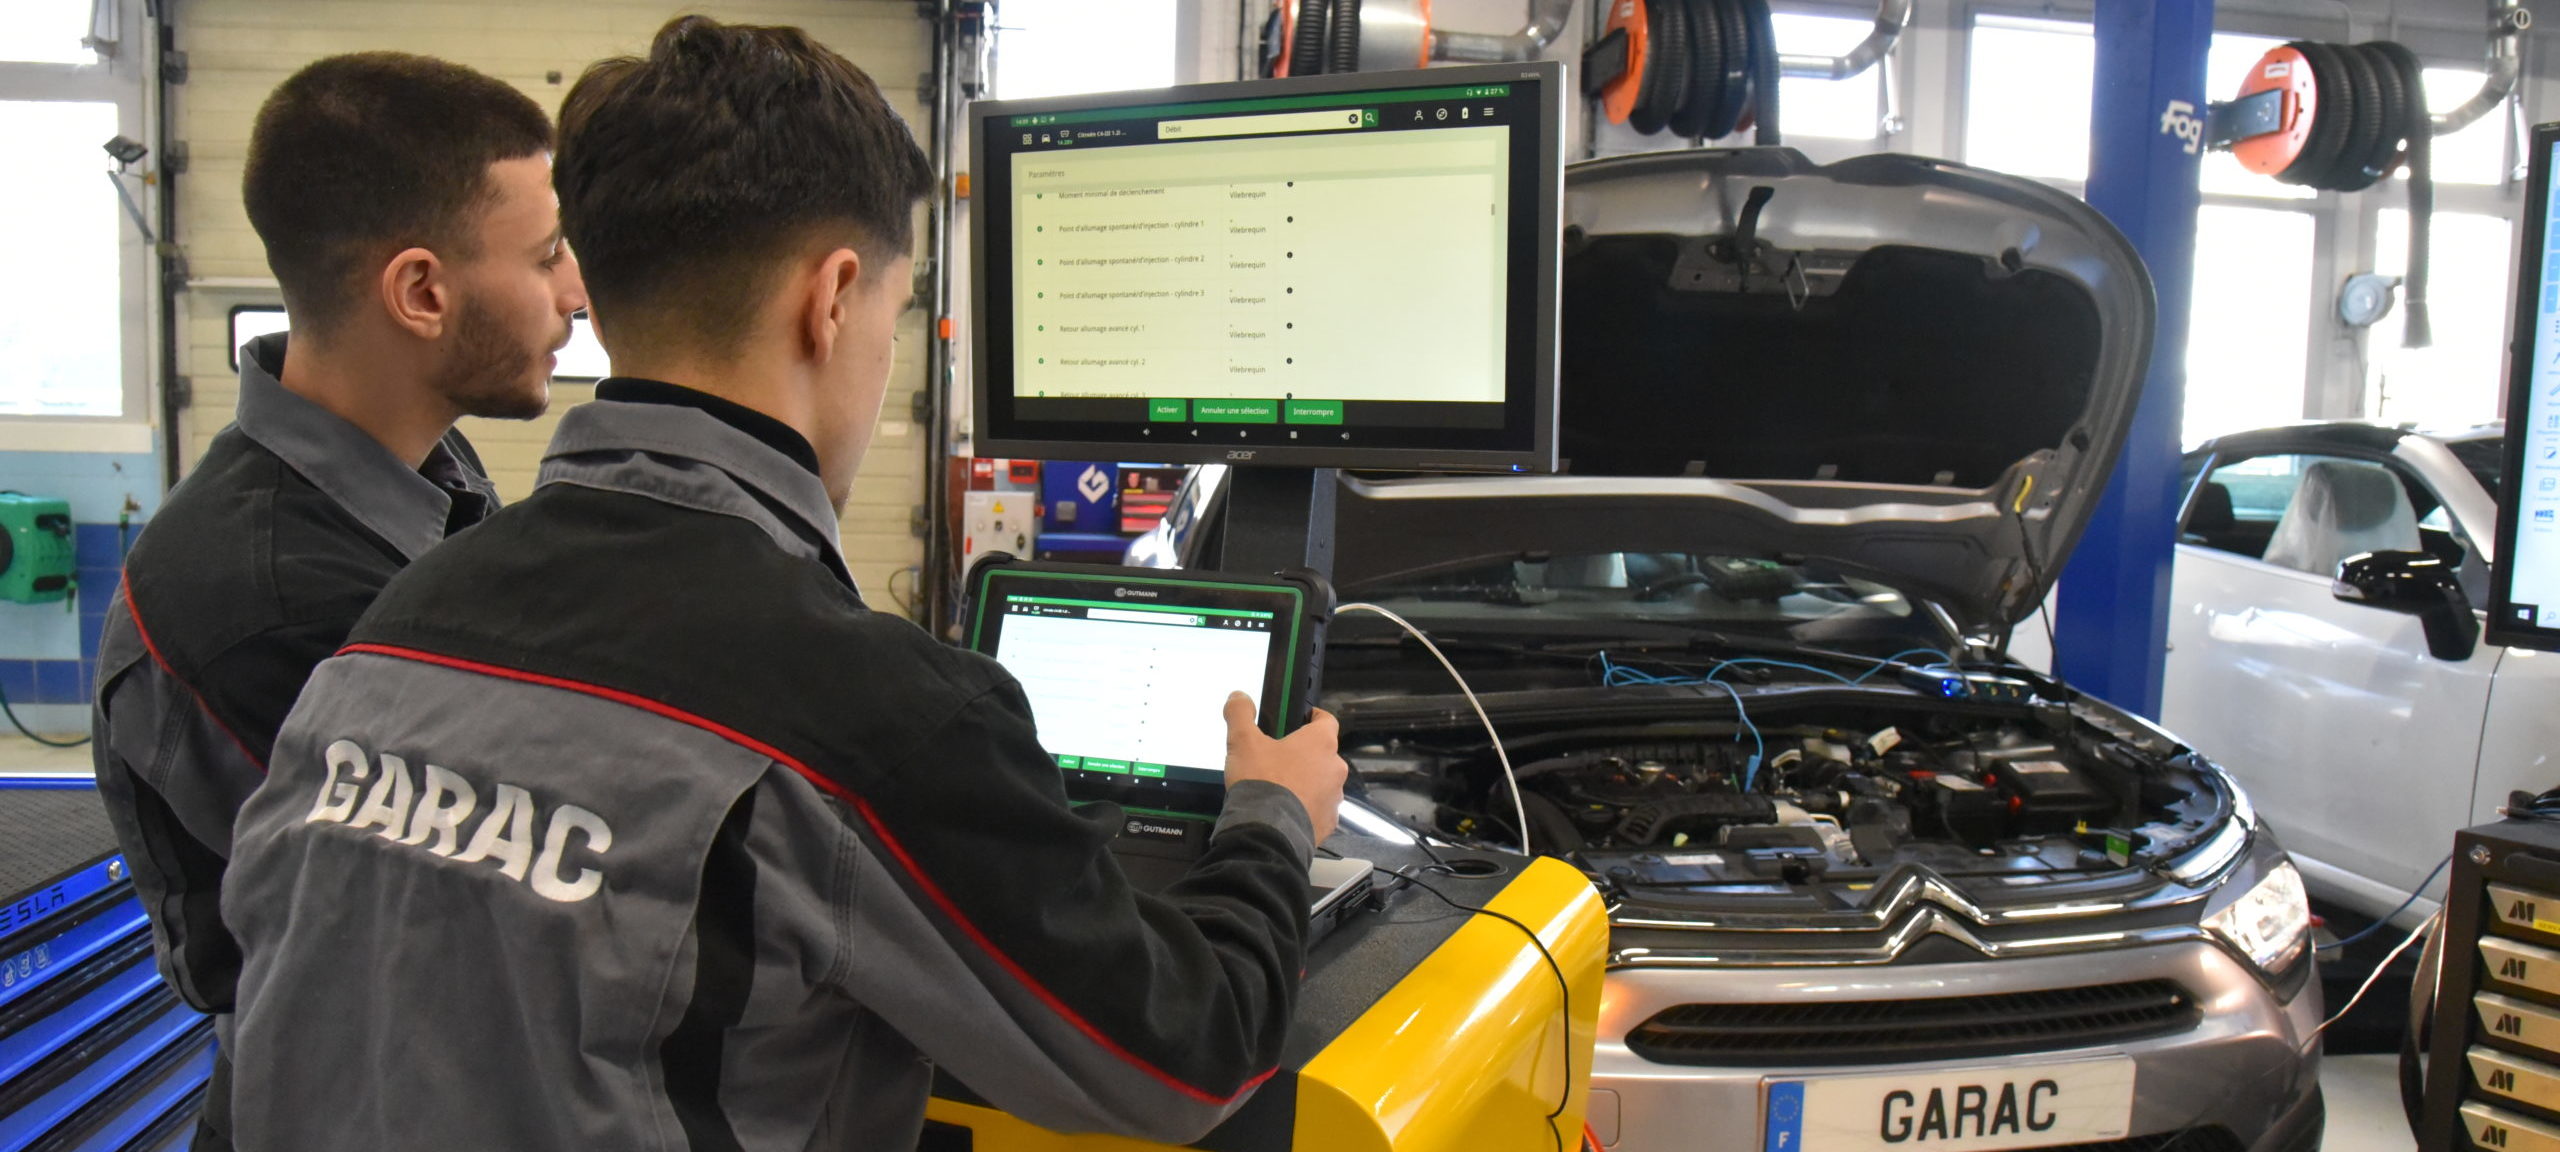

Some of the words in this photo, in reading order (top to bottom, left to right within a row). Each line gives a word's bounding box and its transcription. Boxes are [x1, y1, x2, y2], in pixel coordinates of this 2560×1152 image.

[1165, 125, 1182, 133] Débit
[2160, 99, 2203, 155] Fog
[1229, 191, 1266, 200] Vilebrequin
[1174, 220, 1199, 229] cylindre
[1229, 226, 1266, 234] Vilebrequin
[1174, 255, 1199, 264] cylindre
[1229, 261, 1266, 270] Vilebrequin
[1174, 289, 1199, 298] cylindre
[1229, 296, 1266, 304] Vilebrequin
[1229, 331, 1266, 340] Vilebrequin
[1229, 366, 1266, 374] Vilebrequin
[1156, 405, 1178, 414] Activer
[1201, 406, 1226, 415] Annuler
[1240, 407, 1269, 415] sélection
[1293, 407, 1334, 417] Interrompre
[1227, 450, 1256, 460] acer
[1127, 590, 1158, 598] GUTMANN
[305, 739, 613, 903] GARAC
[1143, 825, 1183, 836] GUTMANN
[1880, 1079, 2059, 1144] GARAC
[1778, 1132, 1789, 1149] F
